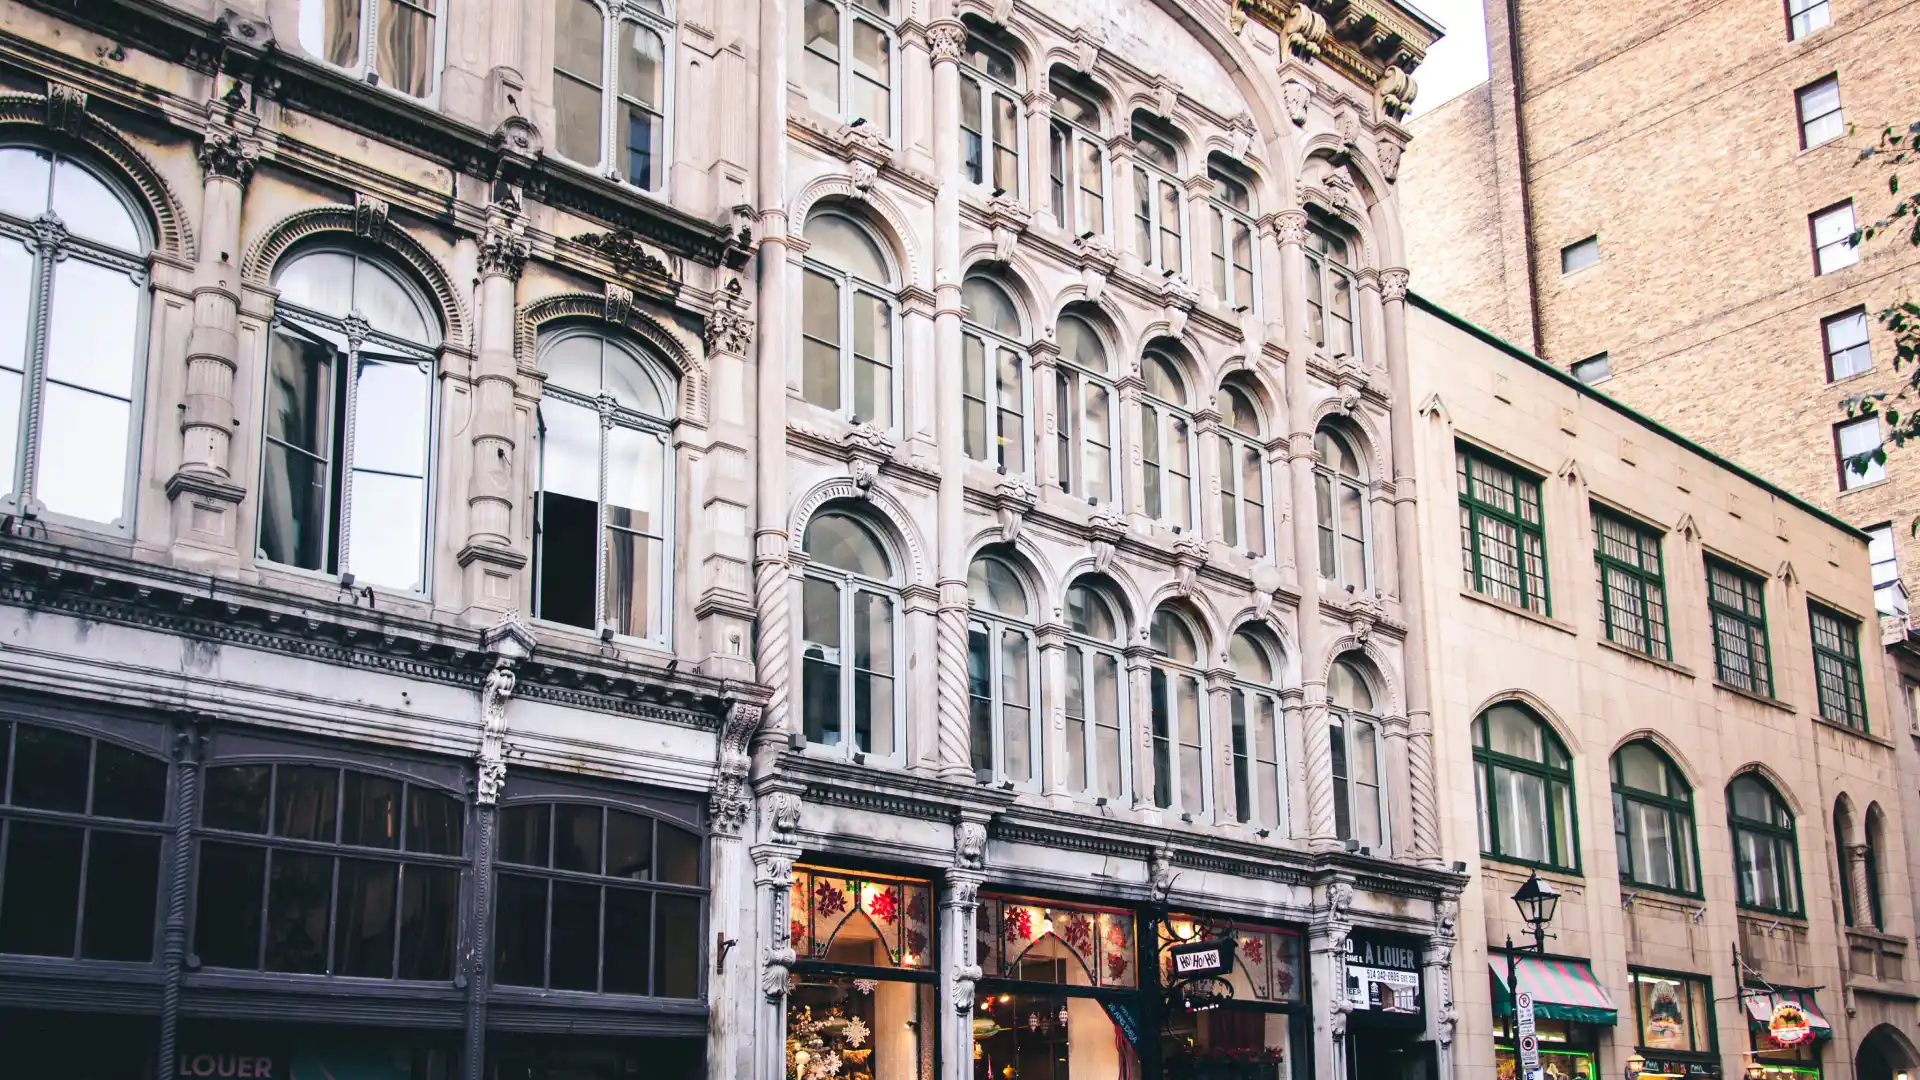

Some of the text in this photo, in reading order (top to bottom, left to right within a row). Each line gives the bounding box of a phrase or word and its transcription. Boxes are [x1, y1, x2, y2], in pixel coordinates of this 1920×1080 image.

[1365, 940, 1415, 969] À LOUER
[1366, 969, 1376, 979] 514
[179, 1053, 272, 1078] LOUER
